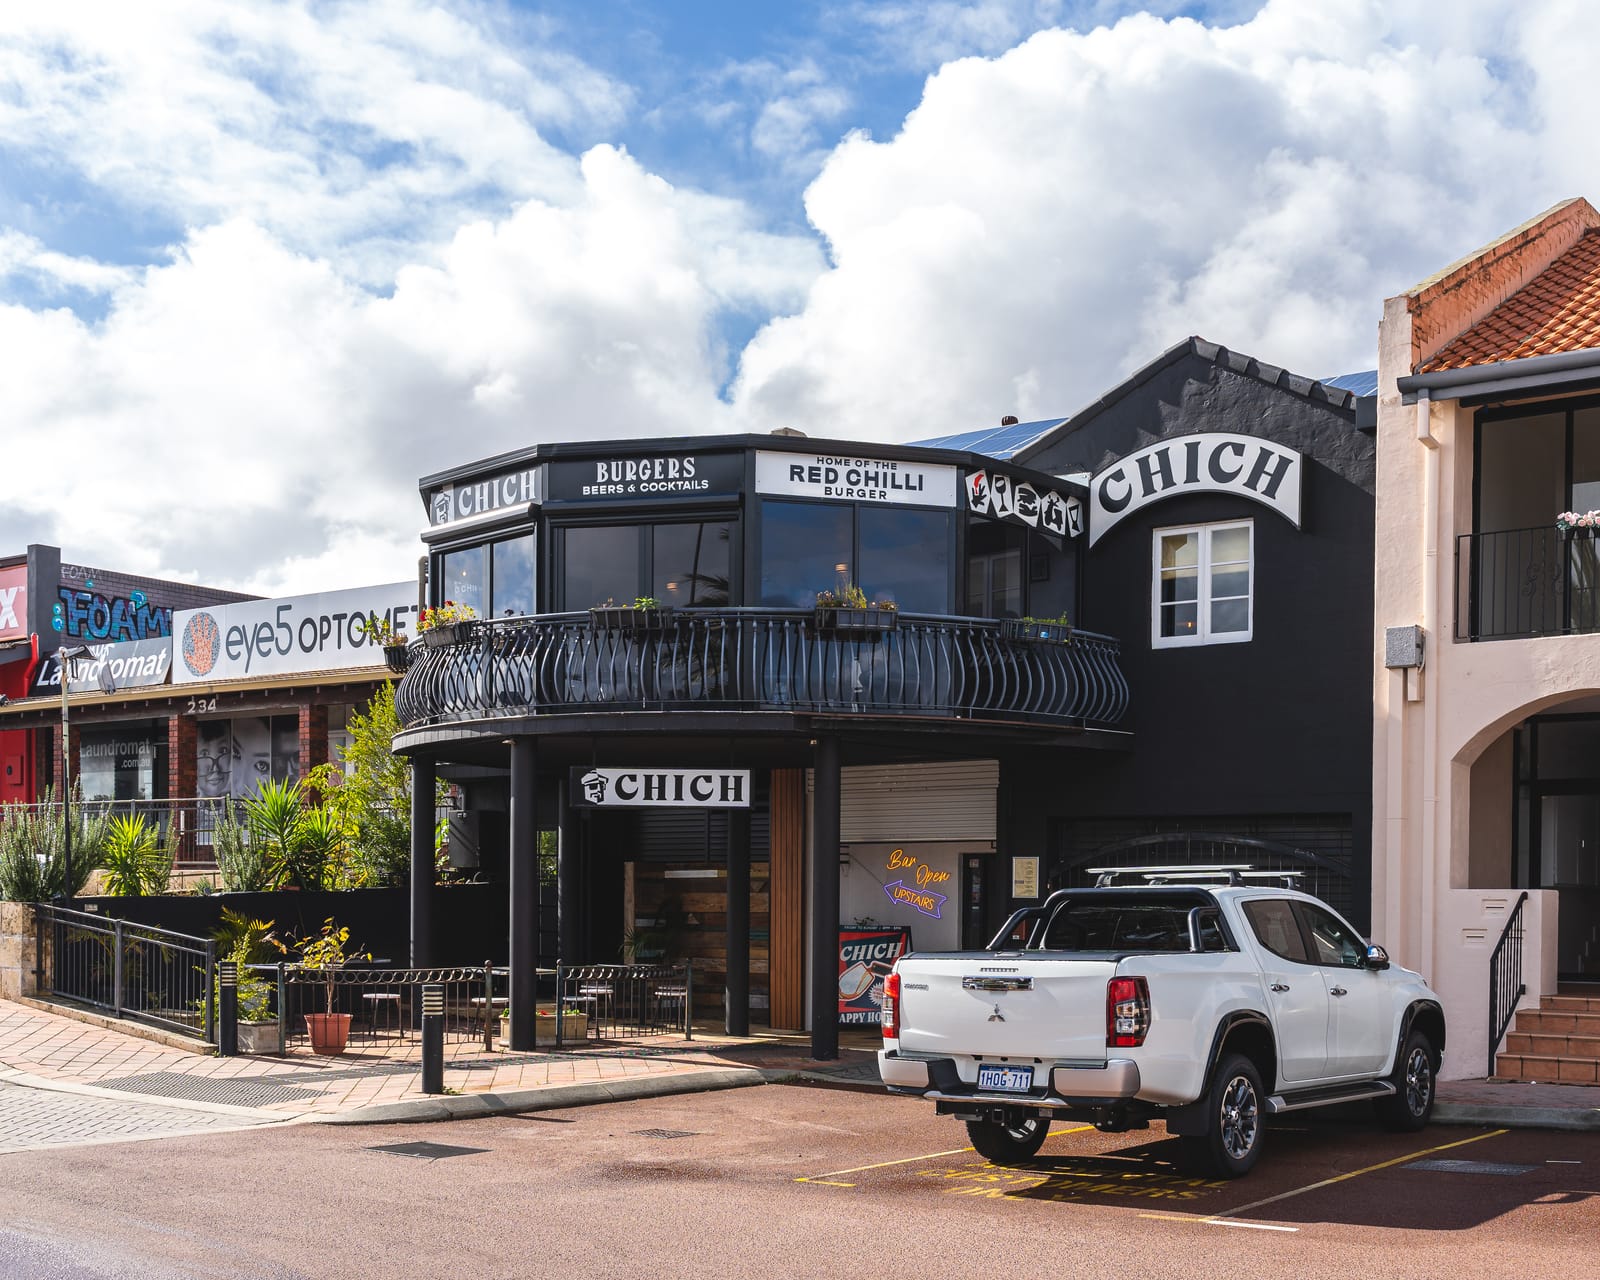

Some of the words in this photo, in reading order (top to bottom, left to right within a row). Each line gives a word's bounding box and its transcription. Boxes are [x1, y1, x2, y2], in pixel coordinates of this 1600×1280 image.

[596, 457, 696, 483] BURGERS
[816, 457, 851, 467] HOME
[855, 460, 870, 468] OF
[874, 461, 898, 470] THE
[582, 484, 624, 496] BEERS
[627, 484, 637, 493] &
[640, 480, 709, 492] COCKTAILS
[789, 464, 839, 485] RED
[846, 469, 924, 491] CHILLI
[1098, 441, 1294, 513] CHICH
[458, 470, 537, 517] CHICH
[824, 486, 887, 500] BURGER
[225, 604, 293, 674] eye5
[187, 698, 217, 714] 234
[80, 738, 150, 757] Laundromat
[614, 774, 744, 802] CHICH
[886, 849, 917, 870] Bar
[916, 864, 951, 889] Open
[893, 887, 935, 910] UPSTAIRS
[840, 942, 903, 961] CHICH
[839, 1011, 866, 1023] APPY
